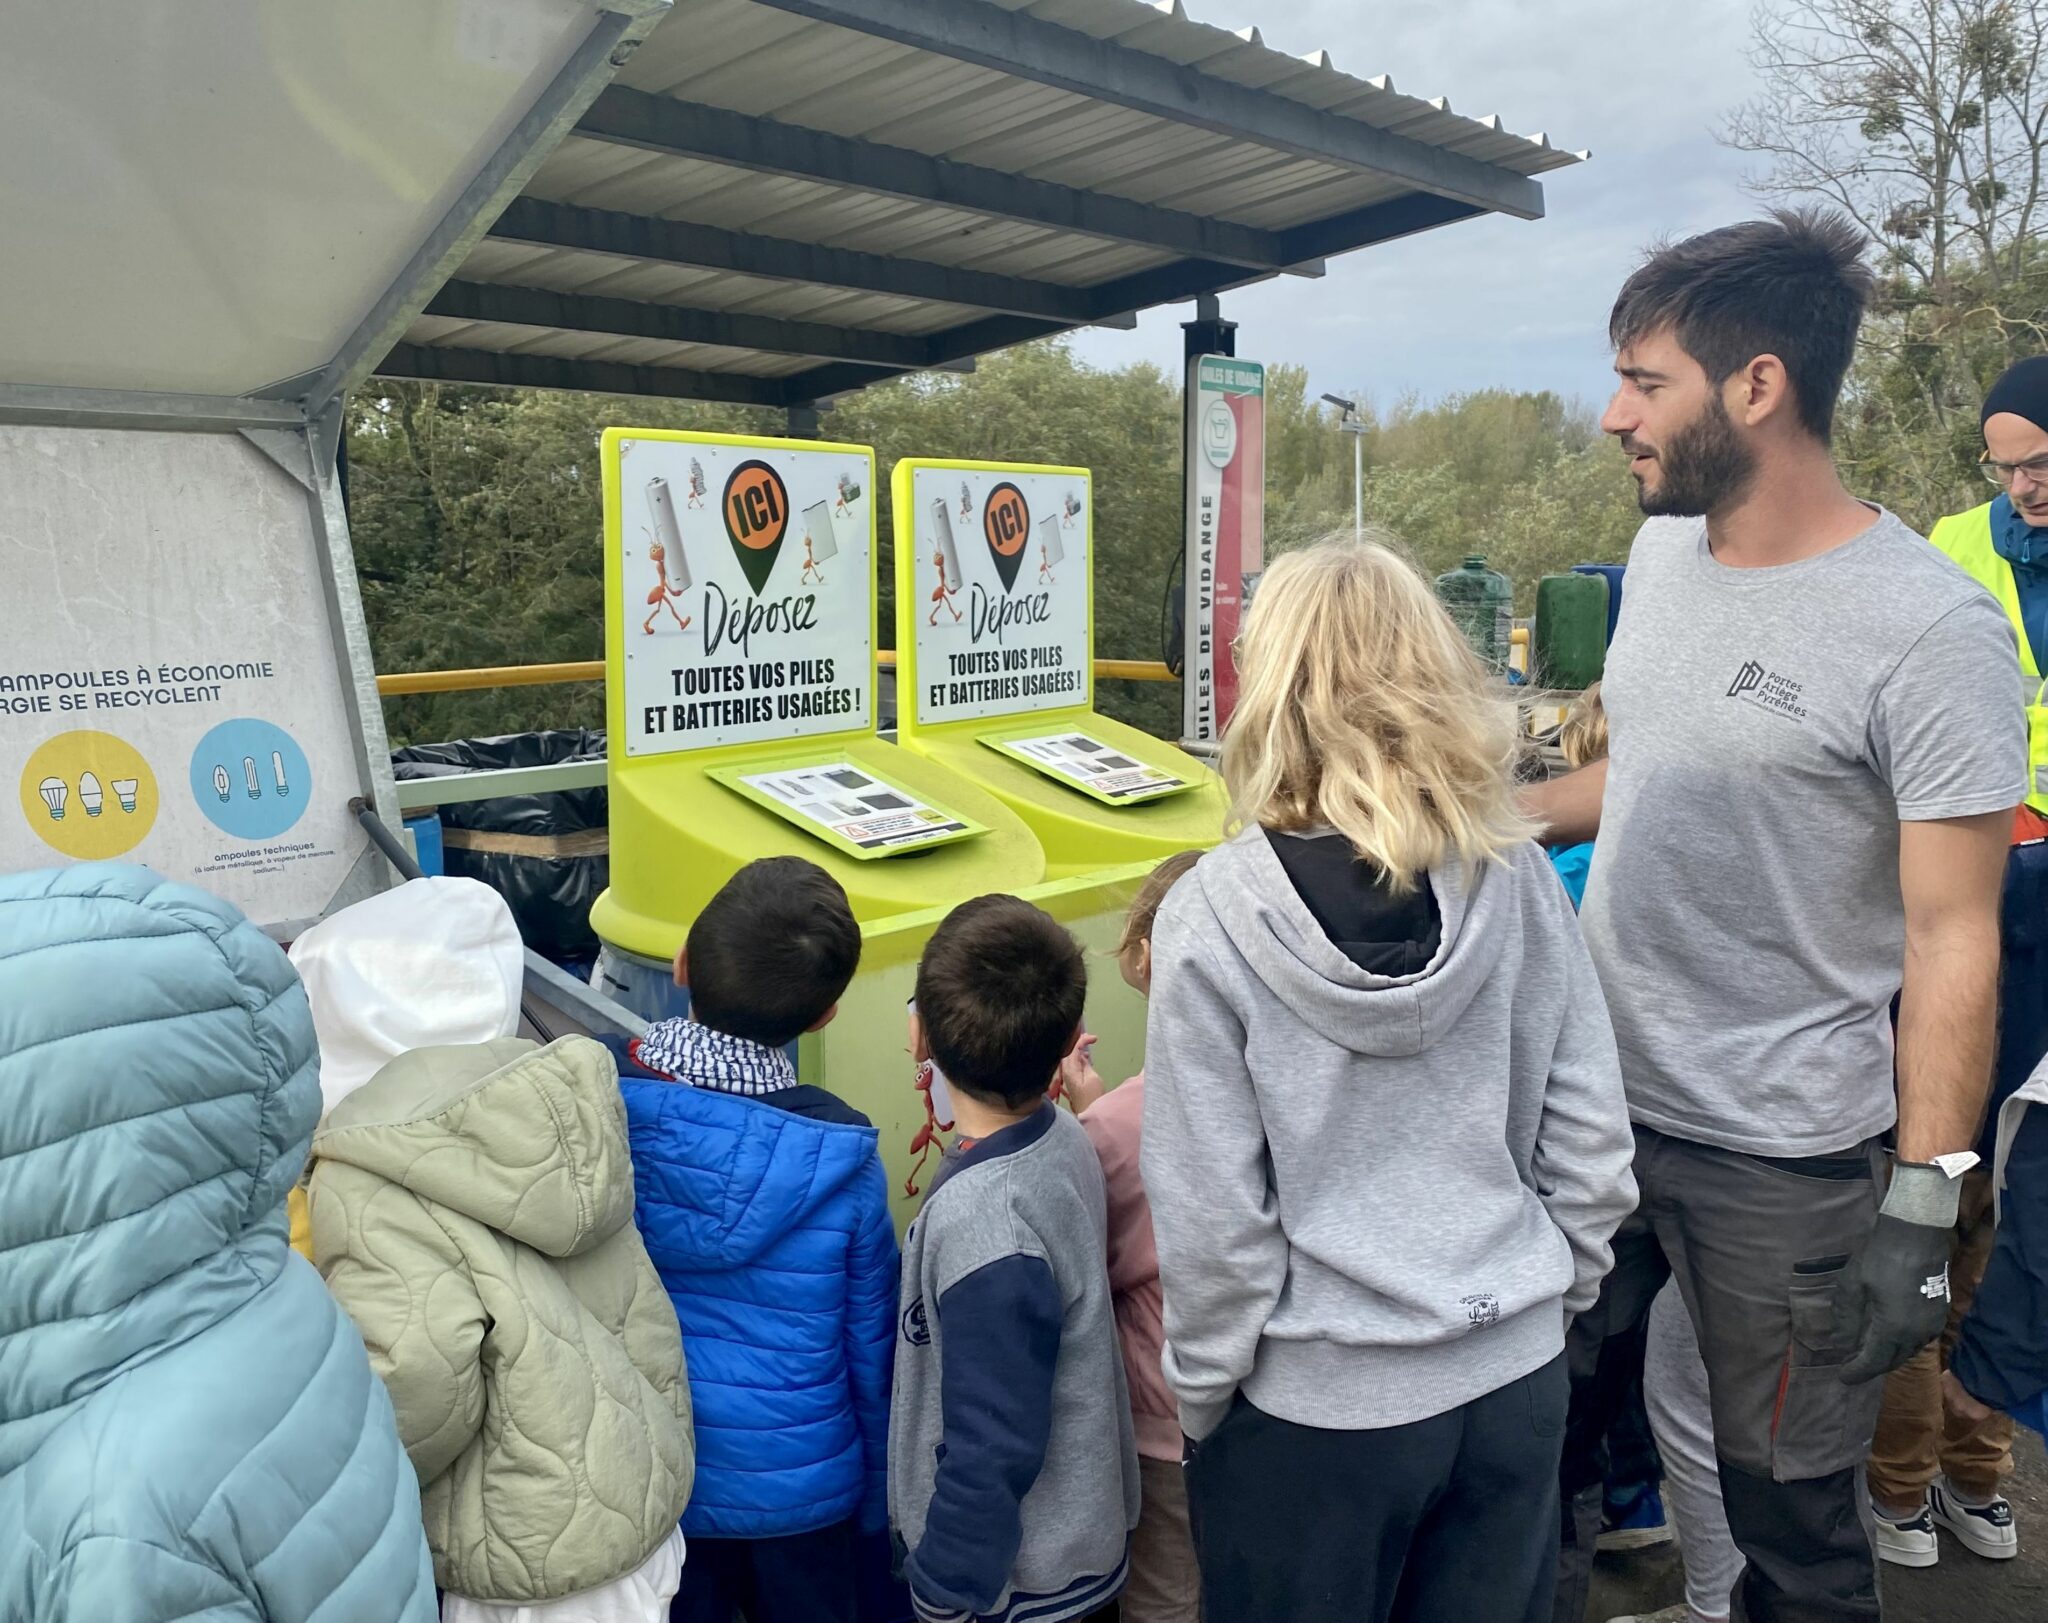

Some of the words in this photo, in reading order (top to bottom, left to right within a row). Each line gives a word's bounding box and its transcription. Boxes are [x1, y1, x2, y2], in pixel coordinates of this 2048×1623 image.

[732, 479, 780, 539] ICI
[990, 497, 1024, 547] ICI
[1200, 496, 1212, 610] VIDANGE
[703, 581, 818, 658] Déposez
[971, 582, 1051, 645] Déposez
[1200, 623, 1211, 654] DE
[0, 669, 130, 692] AMPOULES
[137, 664, 152, 685] À
[158, 662, 274, 684] ÉCONOMIE
[672, 663, 745, 696] TOUTES
[749, 661, 785, 690] VOS
[790, 658, 835, 686] PILES
[949, 650, 999, 677] TOUTES
[1002, 648, 1028, 672] VOS
[1031, 645, 1063, 669] PILES
[59, 693, 88, 711] SE
[94, 685, 221, 709] RECYCLENT
[930, 684, 946, 707] ET
[950, 676, 1019, 705] BATTERIES
[1767, 671, 1804, 693] Portes
[644, 705, 667, 734] ET
[673, 695, 773, 731] BATTERIES
[1199, 668, 1210, 740] UILES
[1756, 690, 1808, 717] Pyrénées
[214, 849, 262, 862] ampoules
[263, 842, 315, 855] techniques
